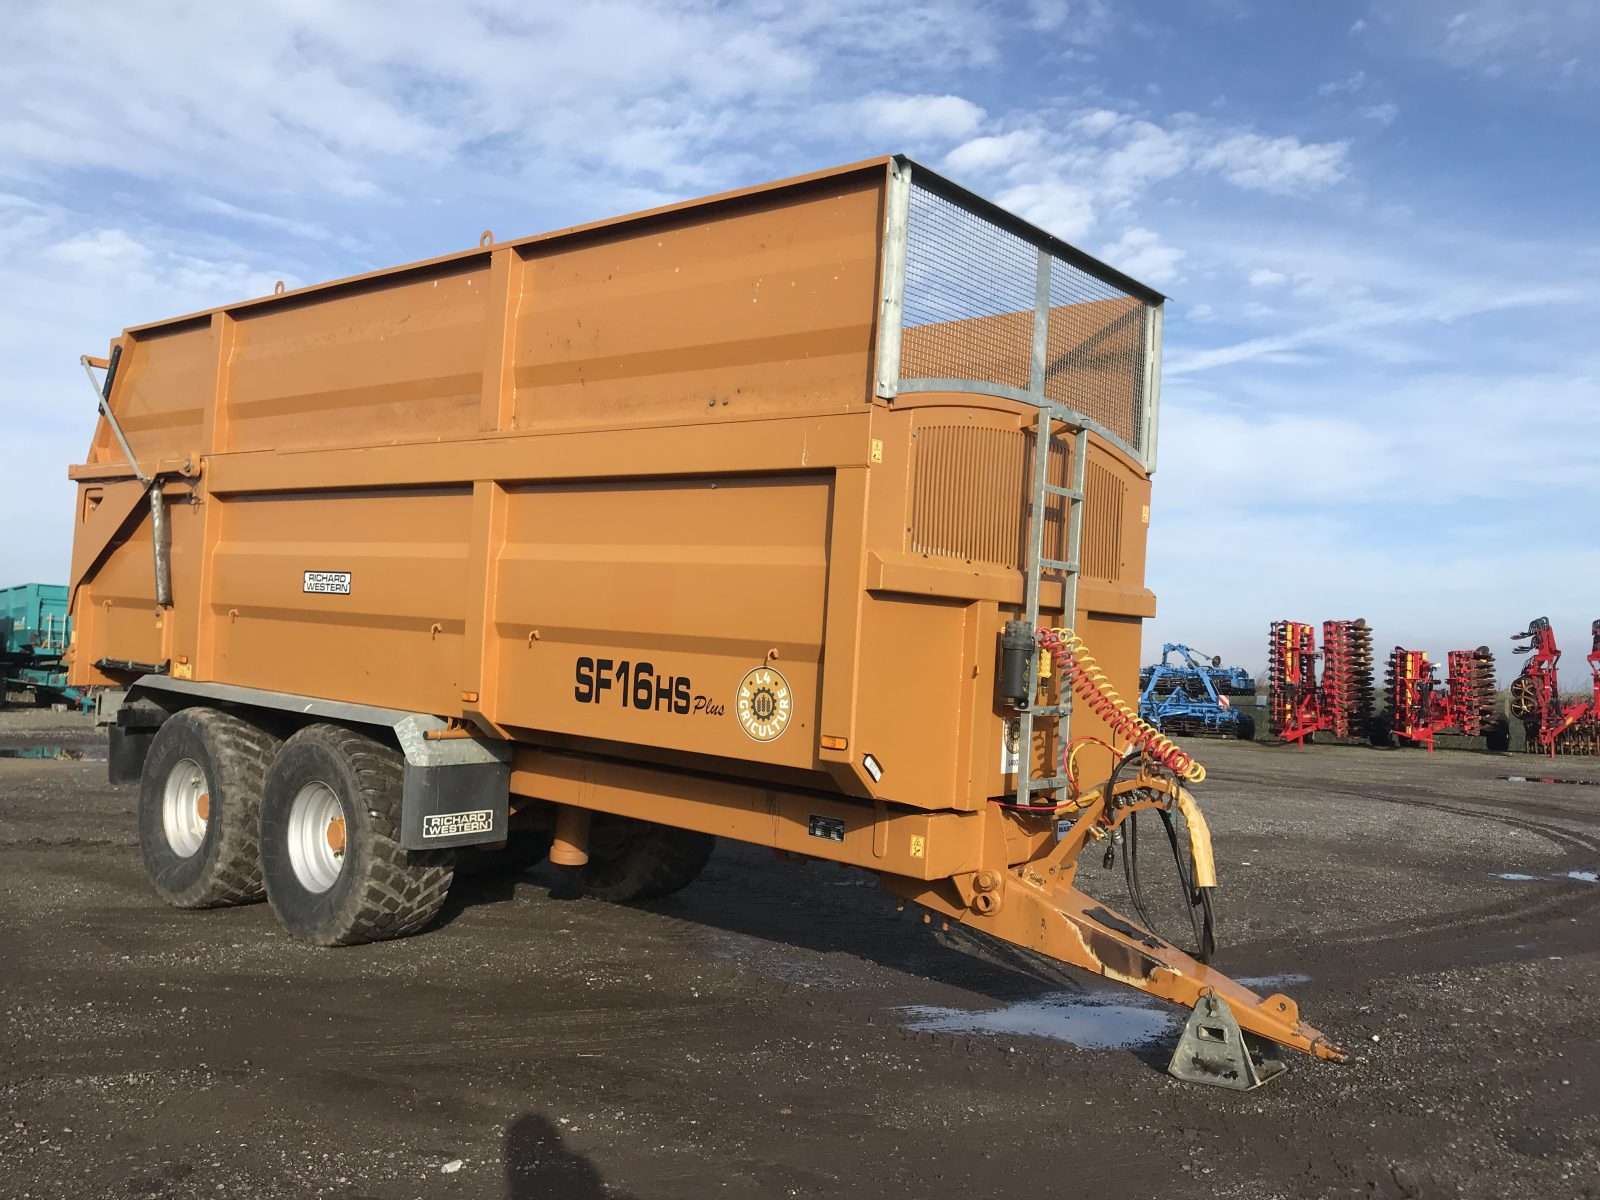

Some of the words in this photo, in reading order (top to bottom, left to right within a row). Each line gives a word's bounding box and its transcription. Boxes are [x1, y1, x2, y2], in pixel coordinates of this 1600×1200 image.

[308, 574, 347, 583] RICHARD
[306, 582, 348, 592] WESTERN
[755, 672, 771, 685] L4
[693, 695, 725, 716] Plus
[739, 686, 789, 737] AGRICULTURE
[431, 813, 486, 826] RICHARD
[429, 820, 488, 835] WESTERN
